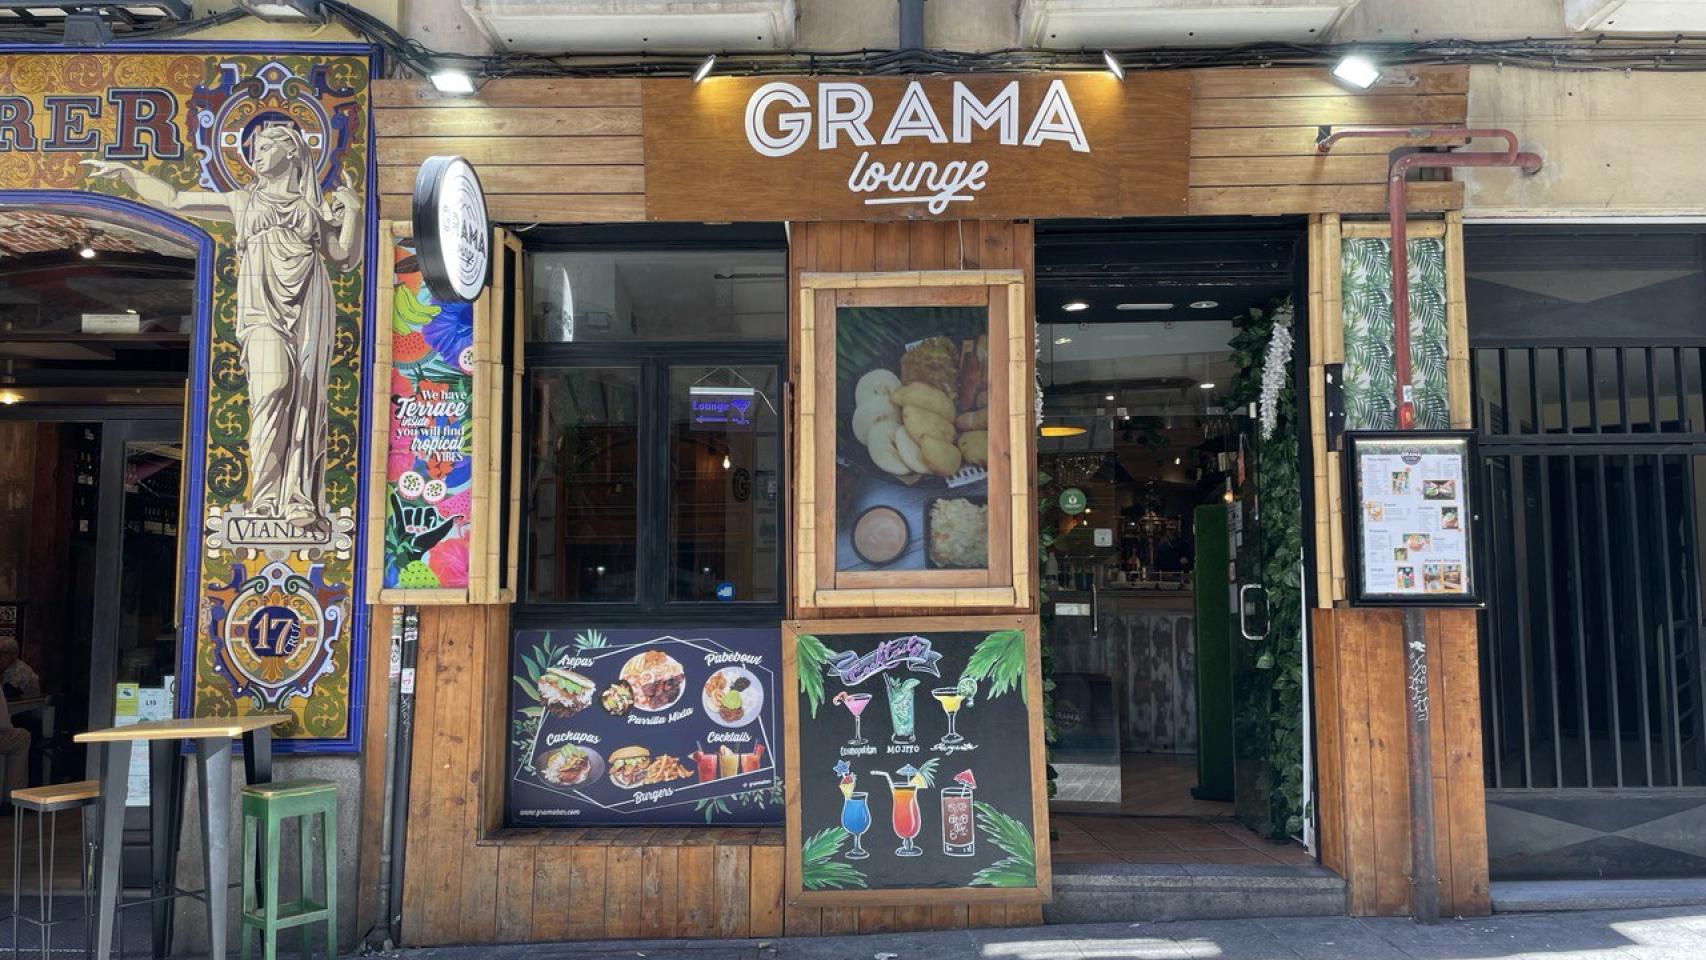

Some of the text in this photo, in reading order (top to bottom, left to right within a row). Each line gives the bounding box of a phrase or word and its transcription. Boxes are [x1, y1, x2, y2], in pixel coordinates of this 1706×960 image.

[0, 87, 184, 160] RER
[745, 80, 1090, 157] GRAMA
[849, 151, 989, 215] lounge
[421, 390, 467, 400] We have
[396, 397, 468, 419] Terrace
[692, 400, 730, 412] Lounge
[397, 426, 464, 440] you will find
[411, 437, 466, 459] tropical
[254, 613, 293, 654] 17
[557, 654, 594, 669] Arepas
[627, 707, 694, 725] Parrilla Mixta
[546, 730, 601, 746] Cachapas
[707, 731, 752, 744] Cocktails
[886, 745, 920, 754] MOJITO
[633, 788, 673, 804] Burgers
